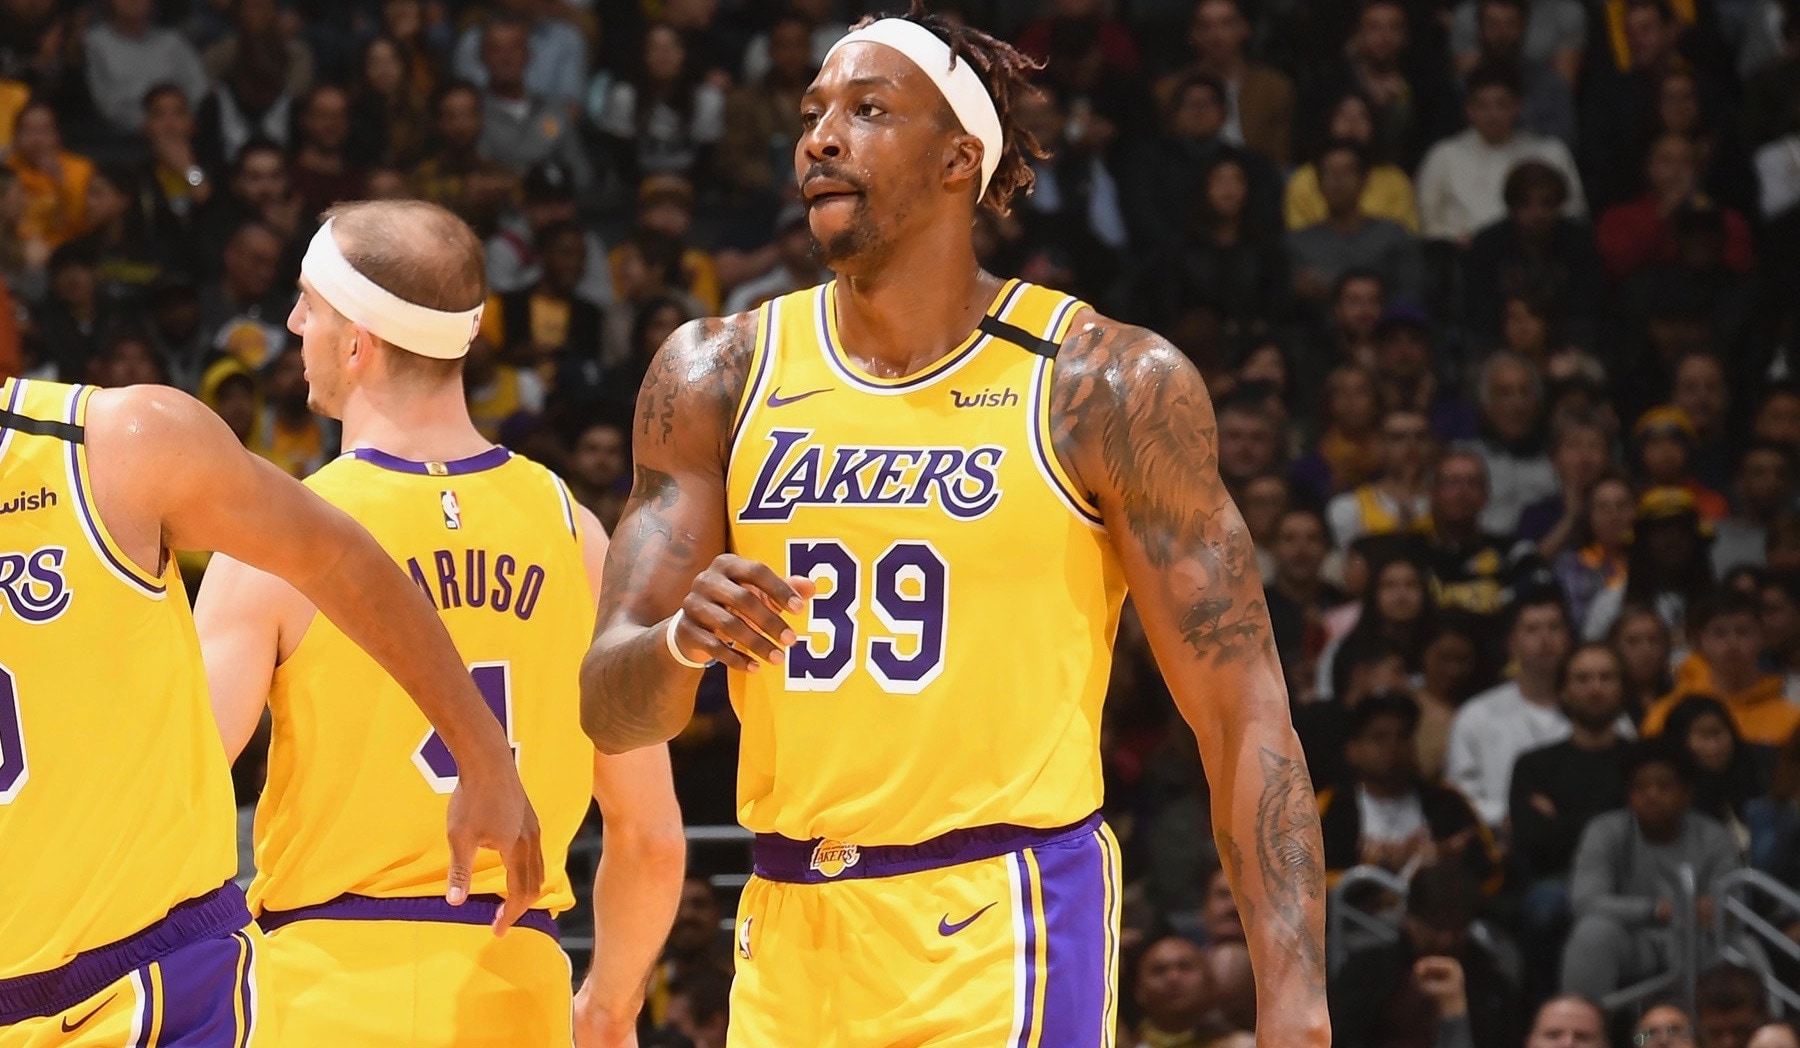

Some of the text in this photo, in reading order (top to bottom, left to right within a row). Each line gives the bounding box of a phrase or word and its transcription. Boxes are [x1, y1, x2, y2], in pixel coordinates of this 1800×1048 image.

[950, 387, 1019, 409] wish
[736, 427, 1008, 524] LAKERS
[407, 549, 545, 620] ARUSO
[784, 538, 950, 695] 39
